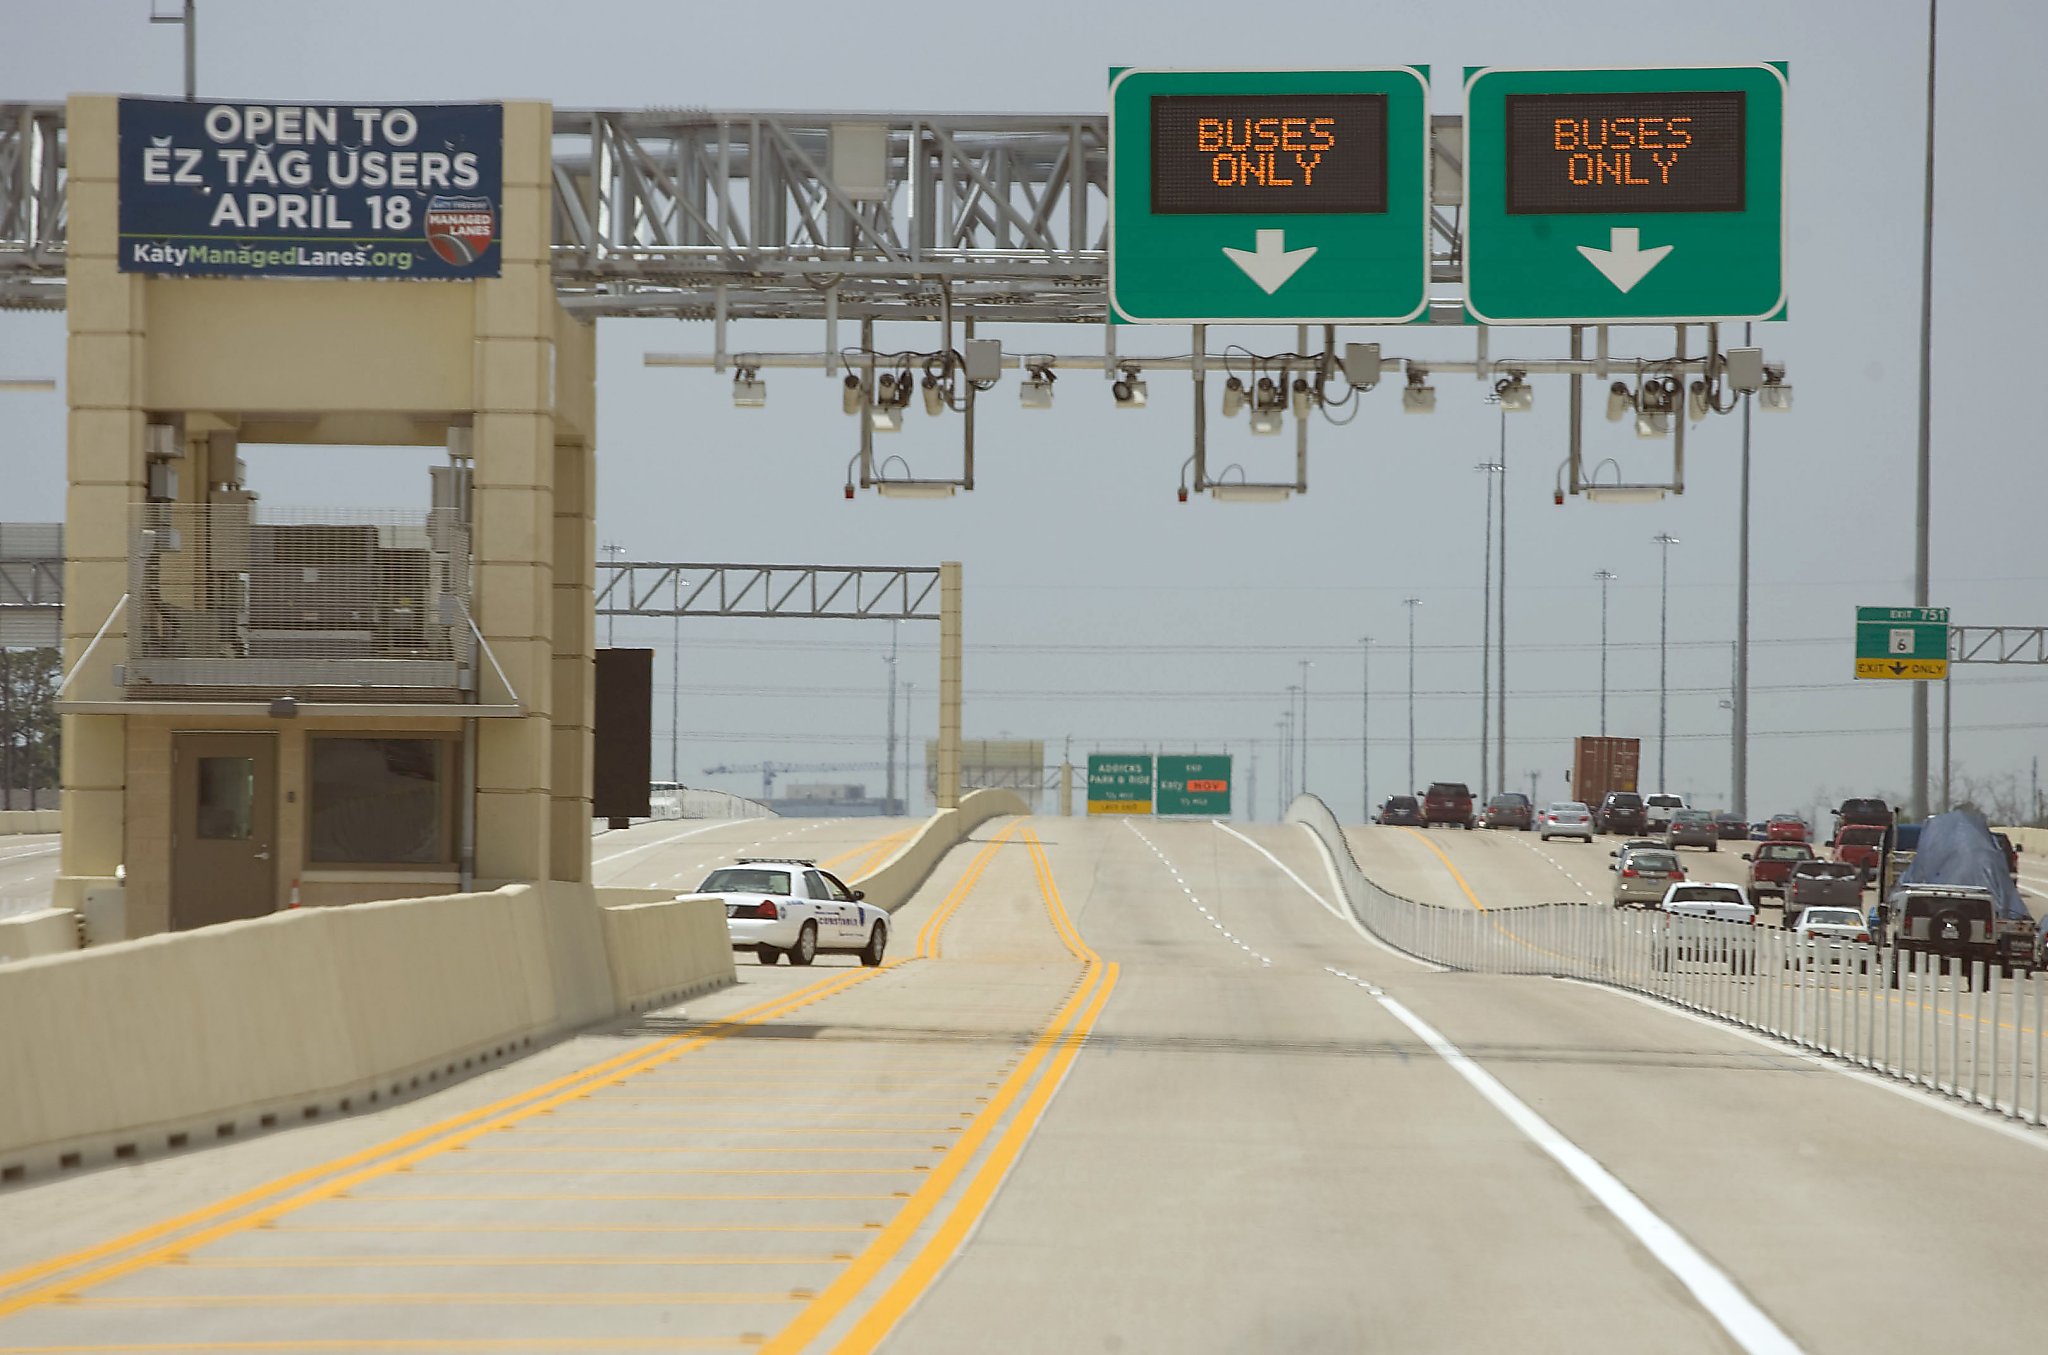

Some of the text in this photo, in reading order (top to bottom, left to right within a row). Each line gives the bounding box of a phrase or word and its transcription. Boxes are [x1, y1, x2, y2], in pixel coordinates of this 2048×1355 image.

[204, 105, 418, 147] OPEN TO
[1198, 117, 1336, 151] BUSES
[1554, 117, 1692, 150] BUSES
[143, 147, 480, 189] EZ TAG USERS
[1212, 152, 1321, 186] ONLY
[1568, 151, 1678, 185] ONLY
[209, 192, 413, 230] APRIL 18
[429, 213, 492, 225] MANAGED
[449, 225, 491, 236] LANES
[133, 243, 413, 270] KatyManagedLanes.org
[1889, 609, 1946, 620] EXIT 751
[1897, 639, 1906, 650] 6
[1858, 664, 1945, 674] EXIT ONLY
